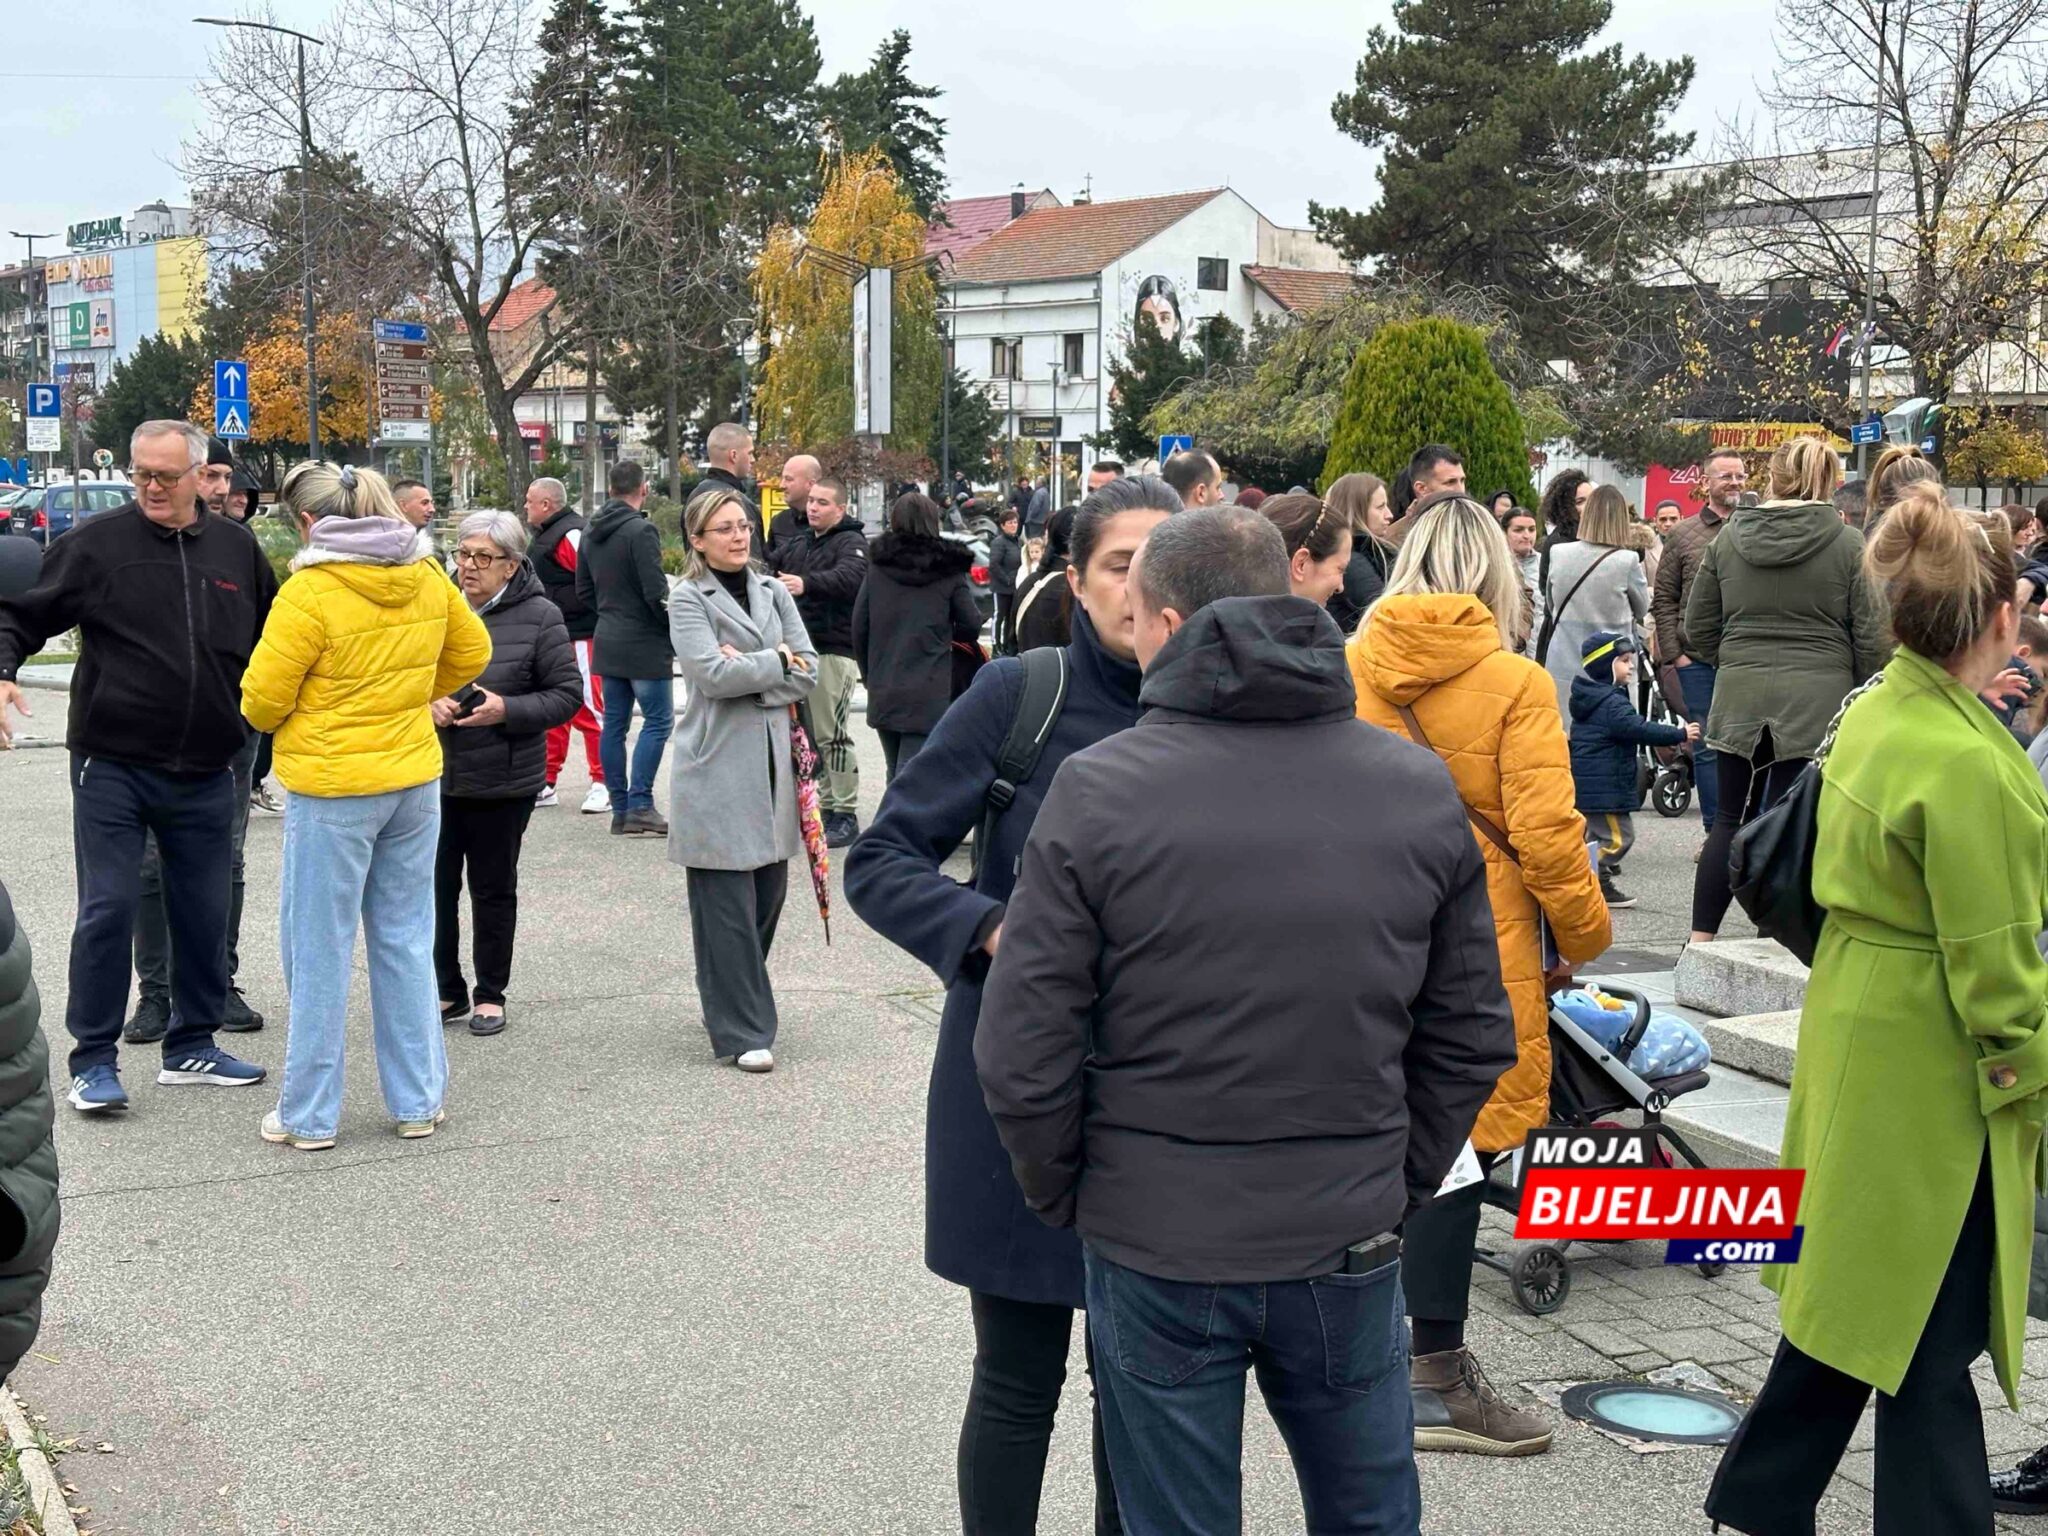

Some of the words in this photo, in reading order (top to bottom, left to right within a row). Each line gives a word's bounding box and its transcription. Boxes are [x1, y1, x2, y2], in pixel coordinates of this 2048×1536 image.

[95, 307, 108, 327] dm
[35, 388, 54, 413] P
[519, 427, 541, 438] SPORT
